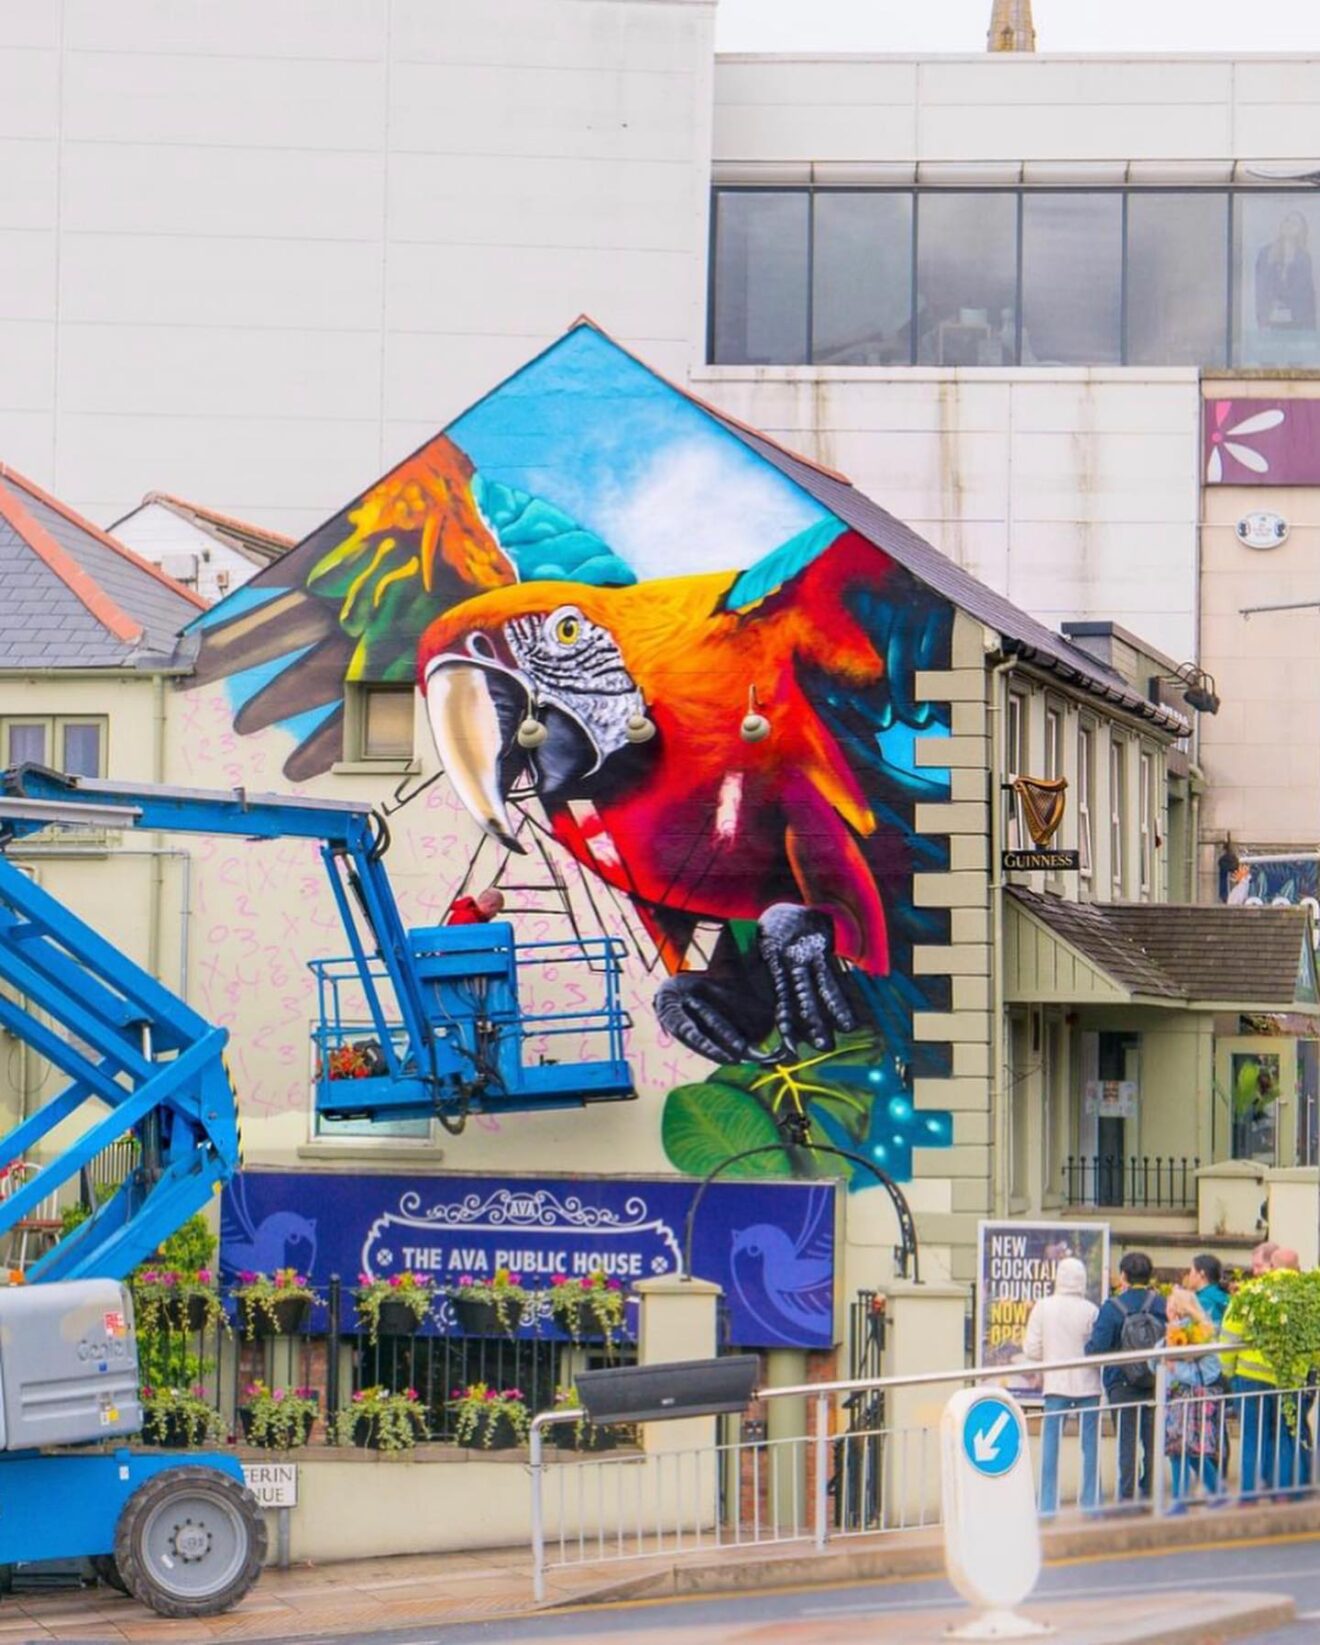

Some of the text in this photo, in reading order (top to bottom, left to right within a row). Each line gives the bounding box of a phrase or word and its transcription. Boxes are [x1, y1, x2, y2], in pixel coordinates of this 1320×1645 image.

[1004, 853, 1073, 868] GUINNESS
[510, 1200, 536, 1217] AVA
[991, 1235, 1027, 1257] NEW
[402, 1248, 643, 1275] THE AVA PUBLIC HOUSE
[991, 1258, 1057, 1280] COCKTAI
[991, 1280, 1053, 1301] LOUNGE
[991, 1301, 1030, 1323] NOW
